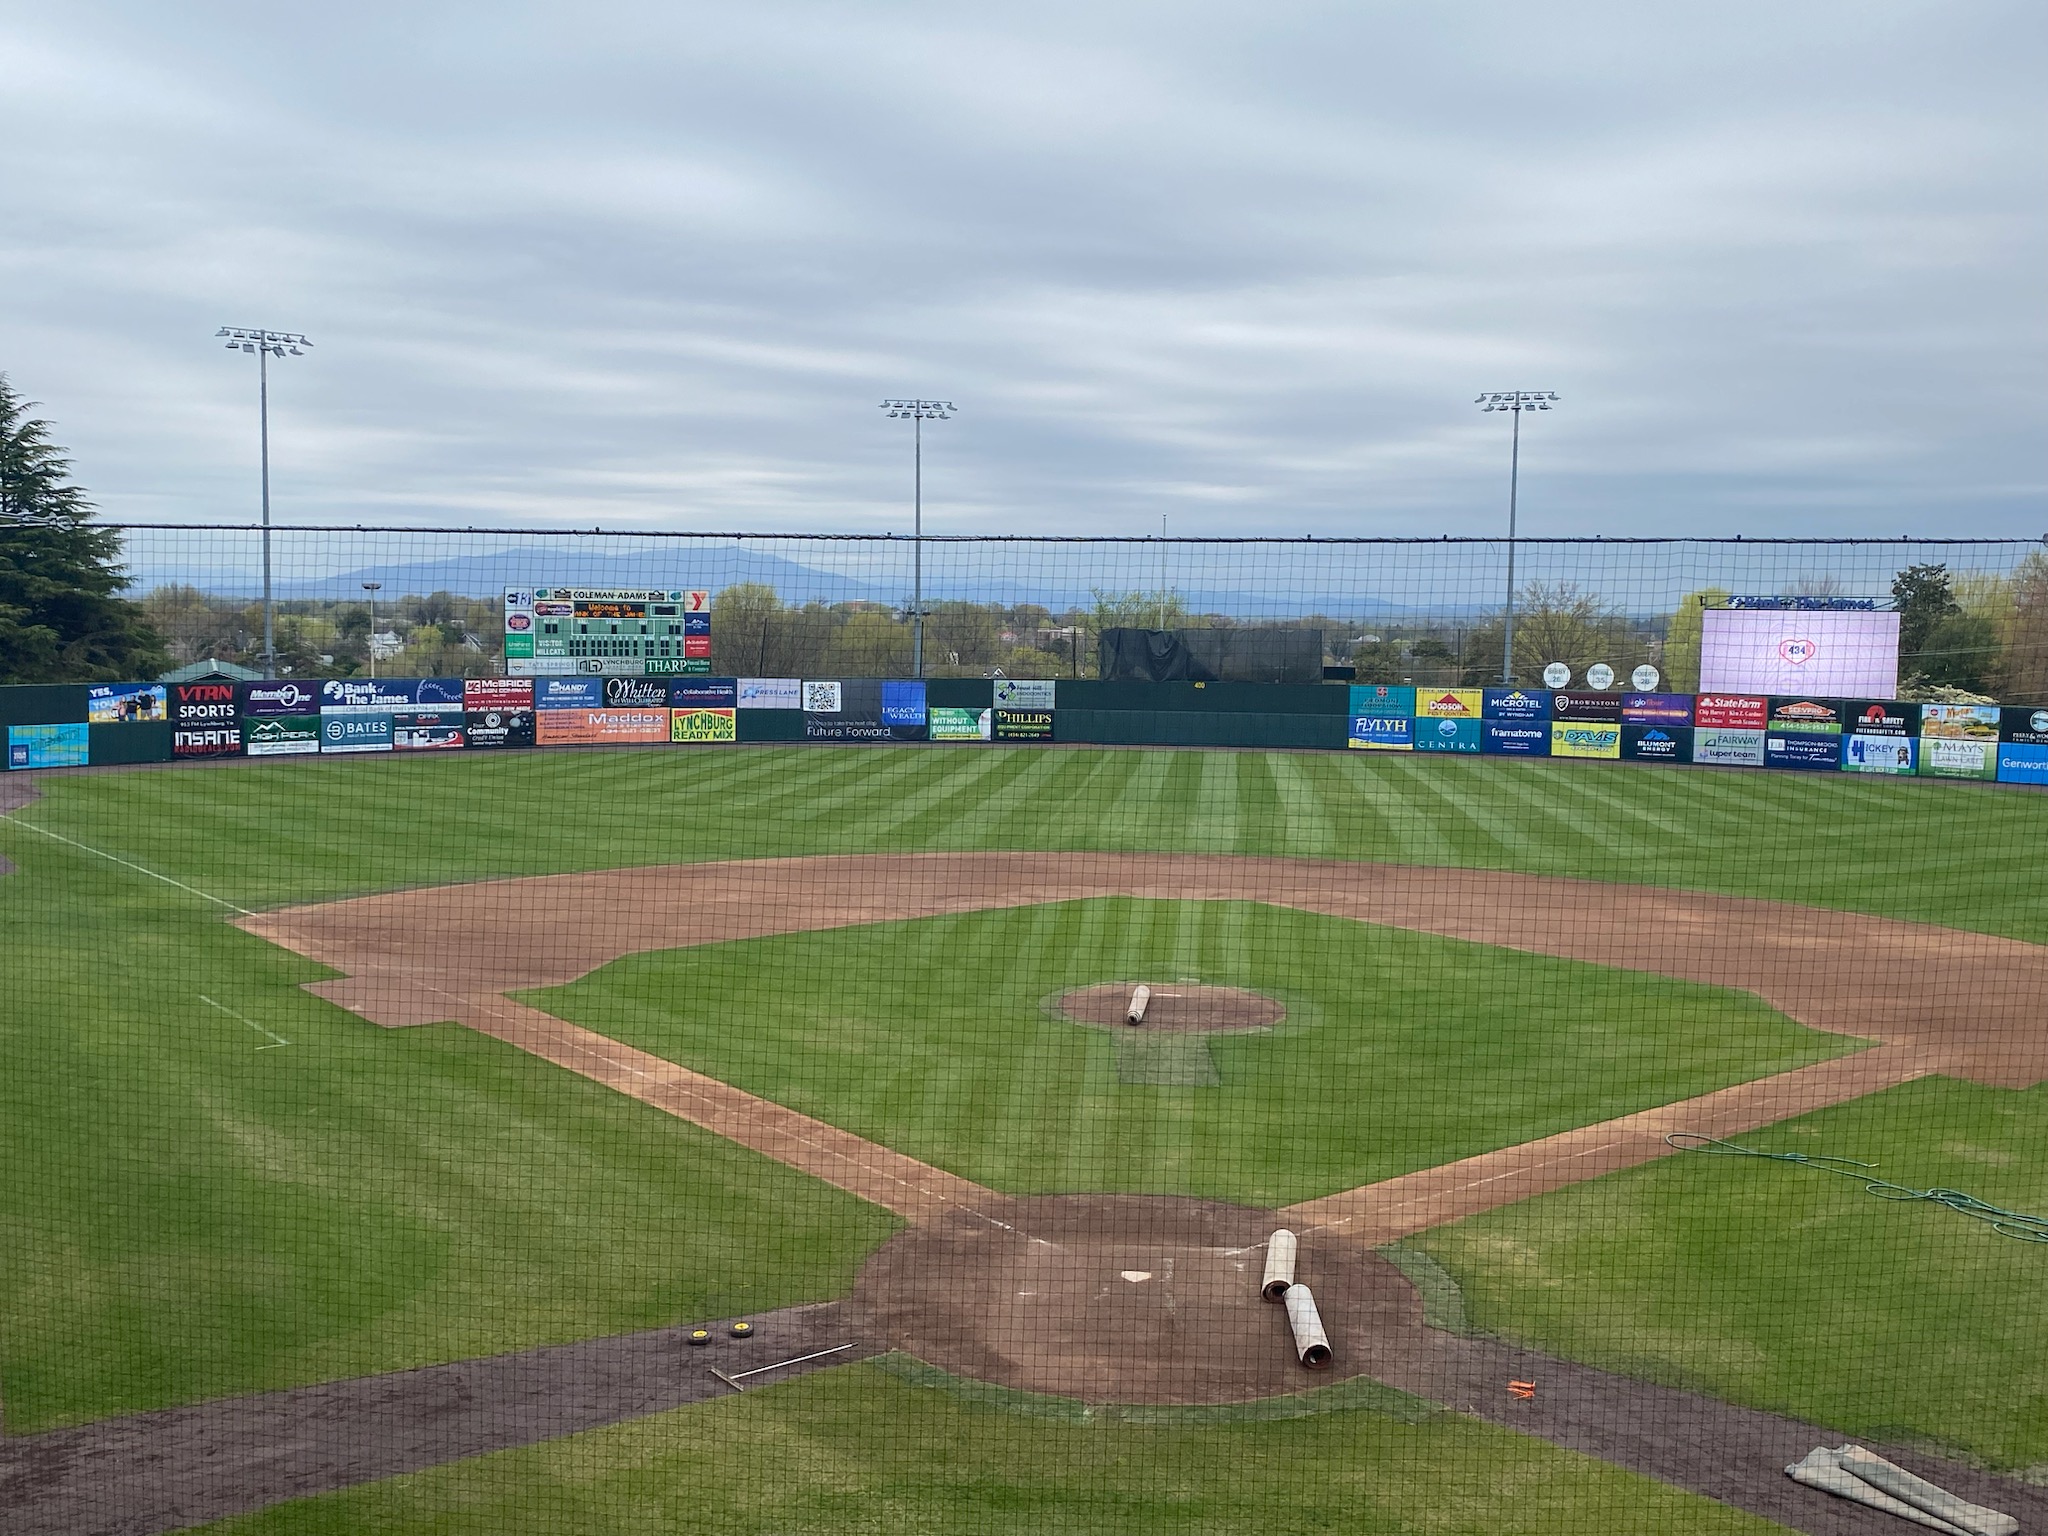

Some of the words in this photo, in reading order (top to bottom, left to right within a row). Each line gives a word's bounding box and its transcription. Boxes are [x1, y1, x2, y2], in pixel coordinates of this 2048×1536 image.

[573, 591, 647, 600] COLEMAN-ADAMS
[1744, 597, 1780, 607] Bank
[1796, 597, 1816, 608] The
[1825, 598, 1874, 610] James
[1789, 646, 1806, 654] 434
[647, 660, 687, 672] THARP
[90, 687, 114, 697] YES,
[345, 683, 377, 694] Bank
[607, 678, 667, 700] Whitten
[250, 689, 294, 700] Member
[345, 695, 367, 704] The
[370, 695, 408, 704] James
[93, 699, 115, 709] YOU
[1429, 701, 1463, 710] DODSON
[1491, 699, 1541, 708] MICROTEL
[1634, 699, 1646, 708] glo
[180, 704, 235, 718] SPORTS
[588, 713, 664, 727] Maddox
[674, 713, 733, 730] LYNCHBURG
[933, 717, 967, 725] WITHOUT
[998, 710, 1051, 723] PHILLIPS
[1882, 716, 1905, 725] SAFETY
[347, 722, 387, 733] BATES
[467, 727, 509, 735] Community
[175, 729, 240, 746] INSANE
[281, 731, 316, 739] PEAK
[674, 731, 710, 739] READY
[714, 731, 733, 739] MIX
[1491, 728, 1542, 738] framatome
[1418, 741, 1477, 749] CENTRA
[1718, 736, 1759, 745] FAIRWAY
[1852, 740, 1894, 763] HICKEY
[1943, 743, 1984, 752] MAY'S
